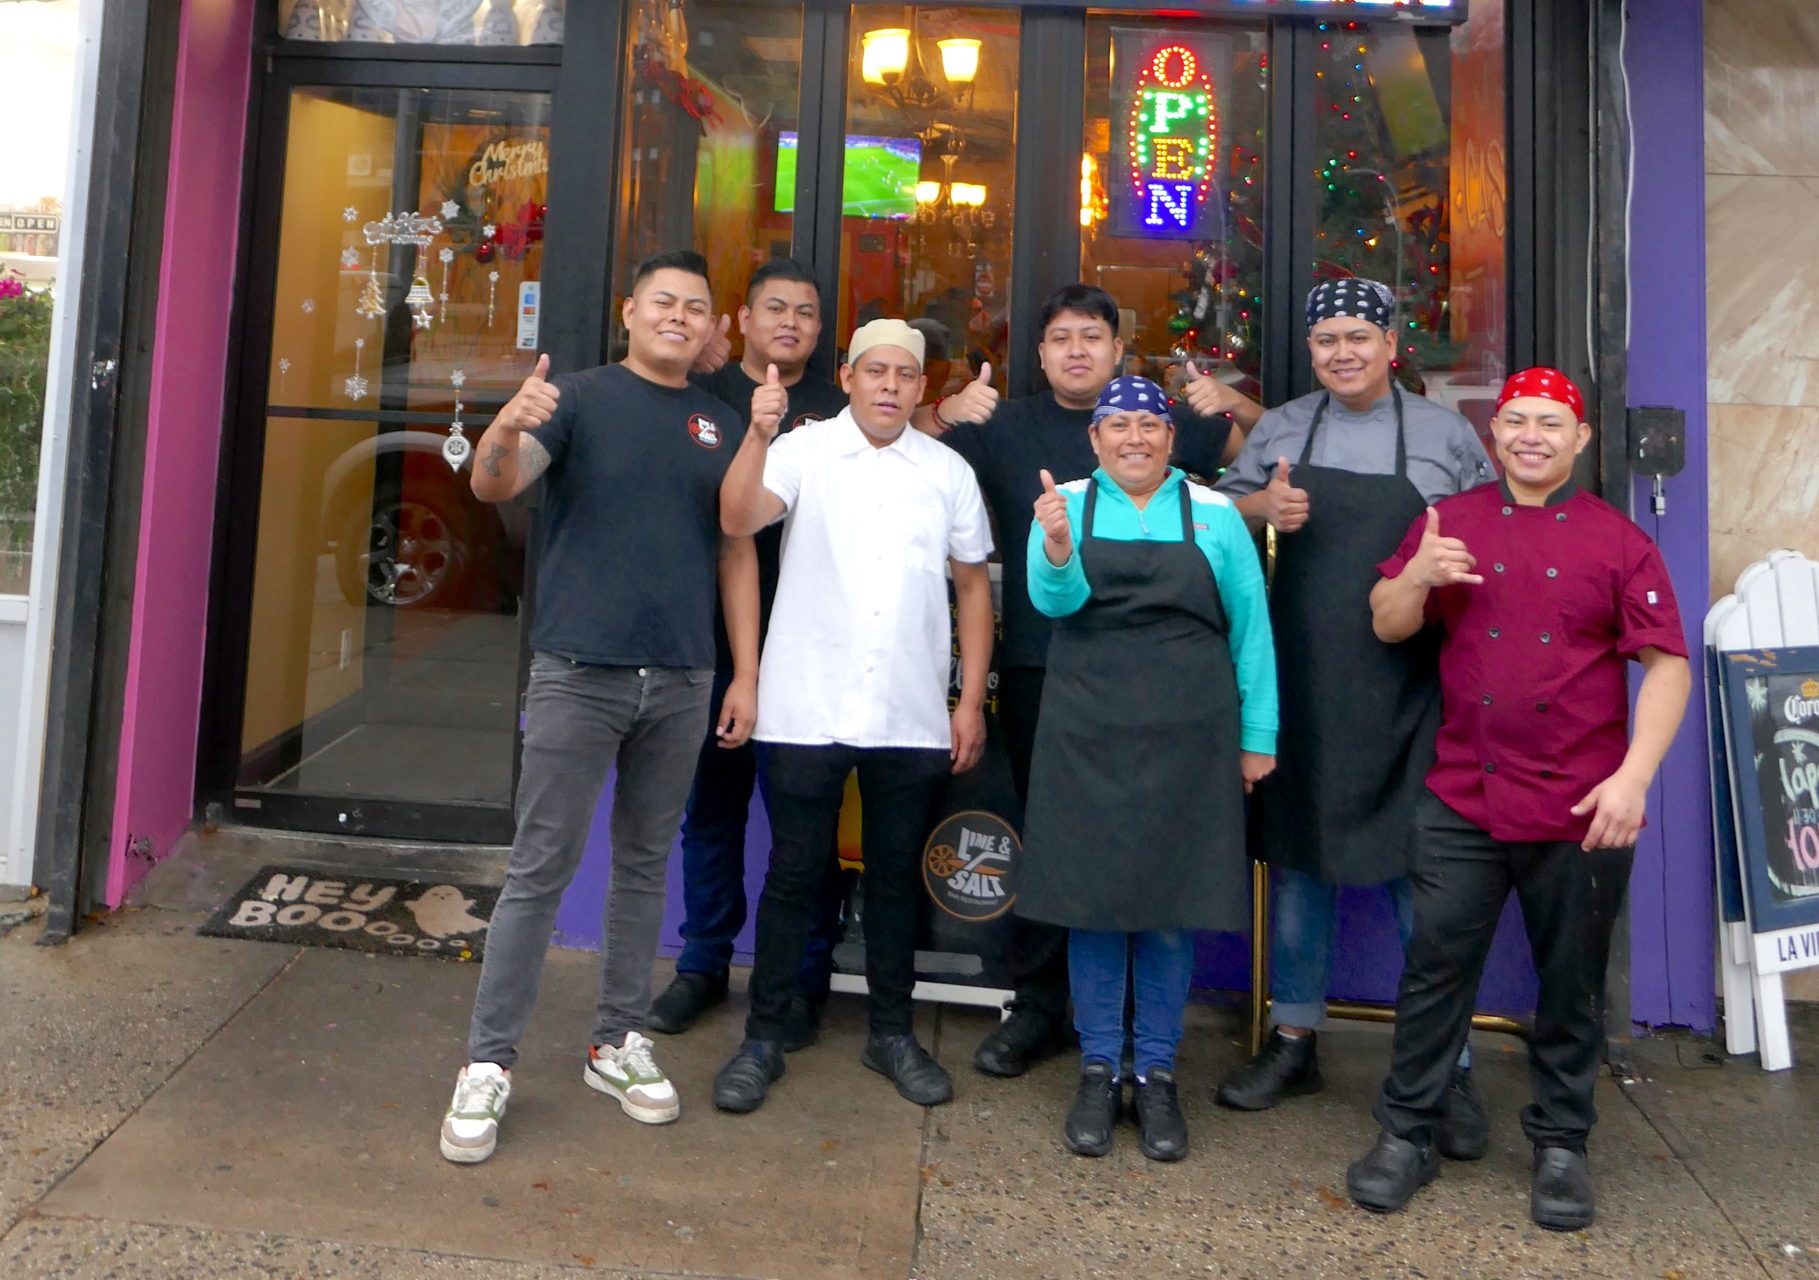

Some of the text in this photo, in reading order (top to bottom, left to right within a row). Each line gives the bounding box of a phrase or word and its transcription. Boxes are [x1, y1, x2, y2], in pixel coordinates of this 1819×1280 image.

[1145, 45, 1196, 227] OPEN
[469, 158, 549, 186] Christma
[16, 218, 55, 229] OPEN
[957, 826, 1012, 862] LIME &
[260, 873, 399, 912] HEY
[946, 870, 1007, 899] SALT
[1777, 935, 1799, 962] LA
